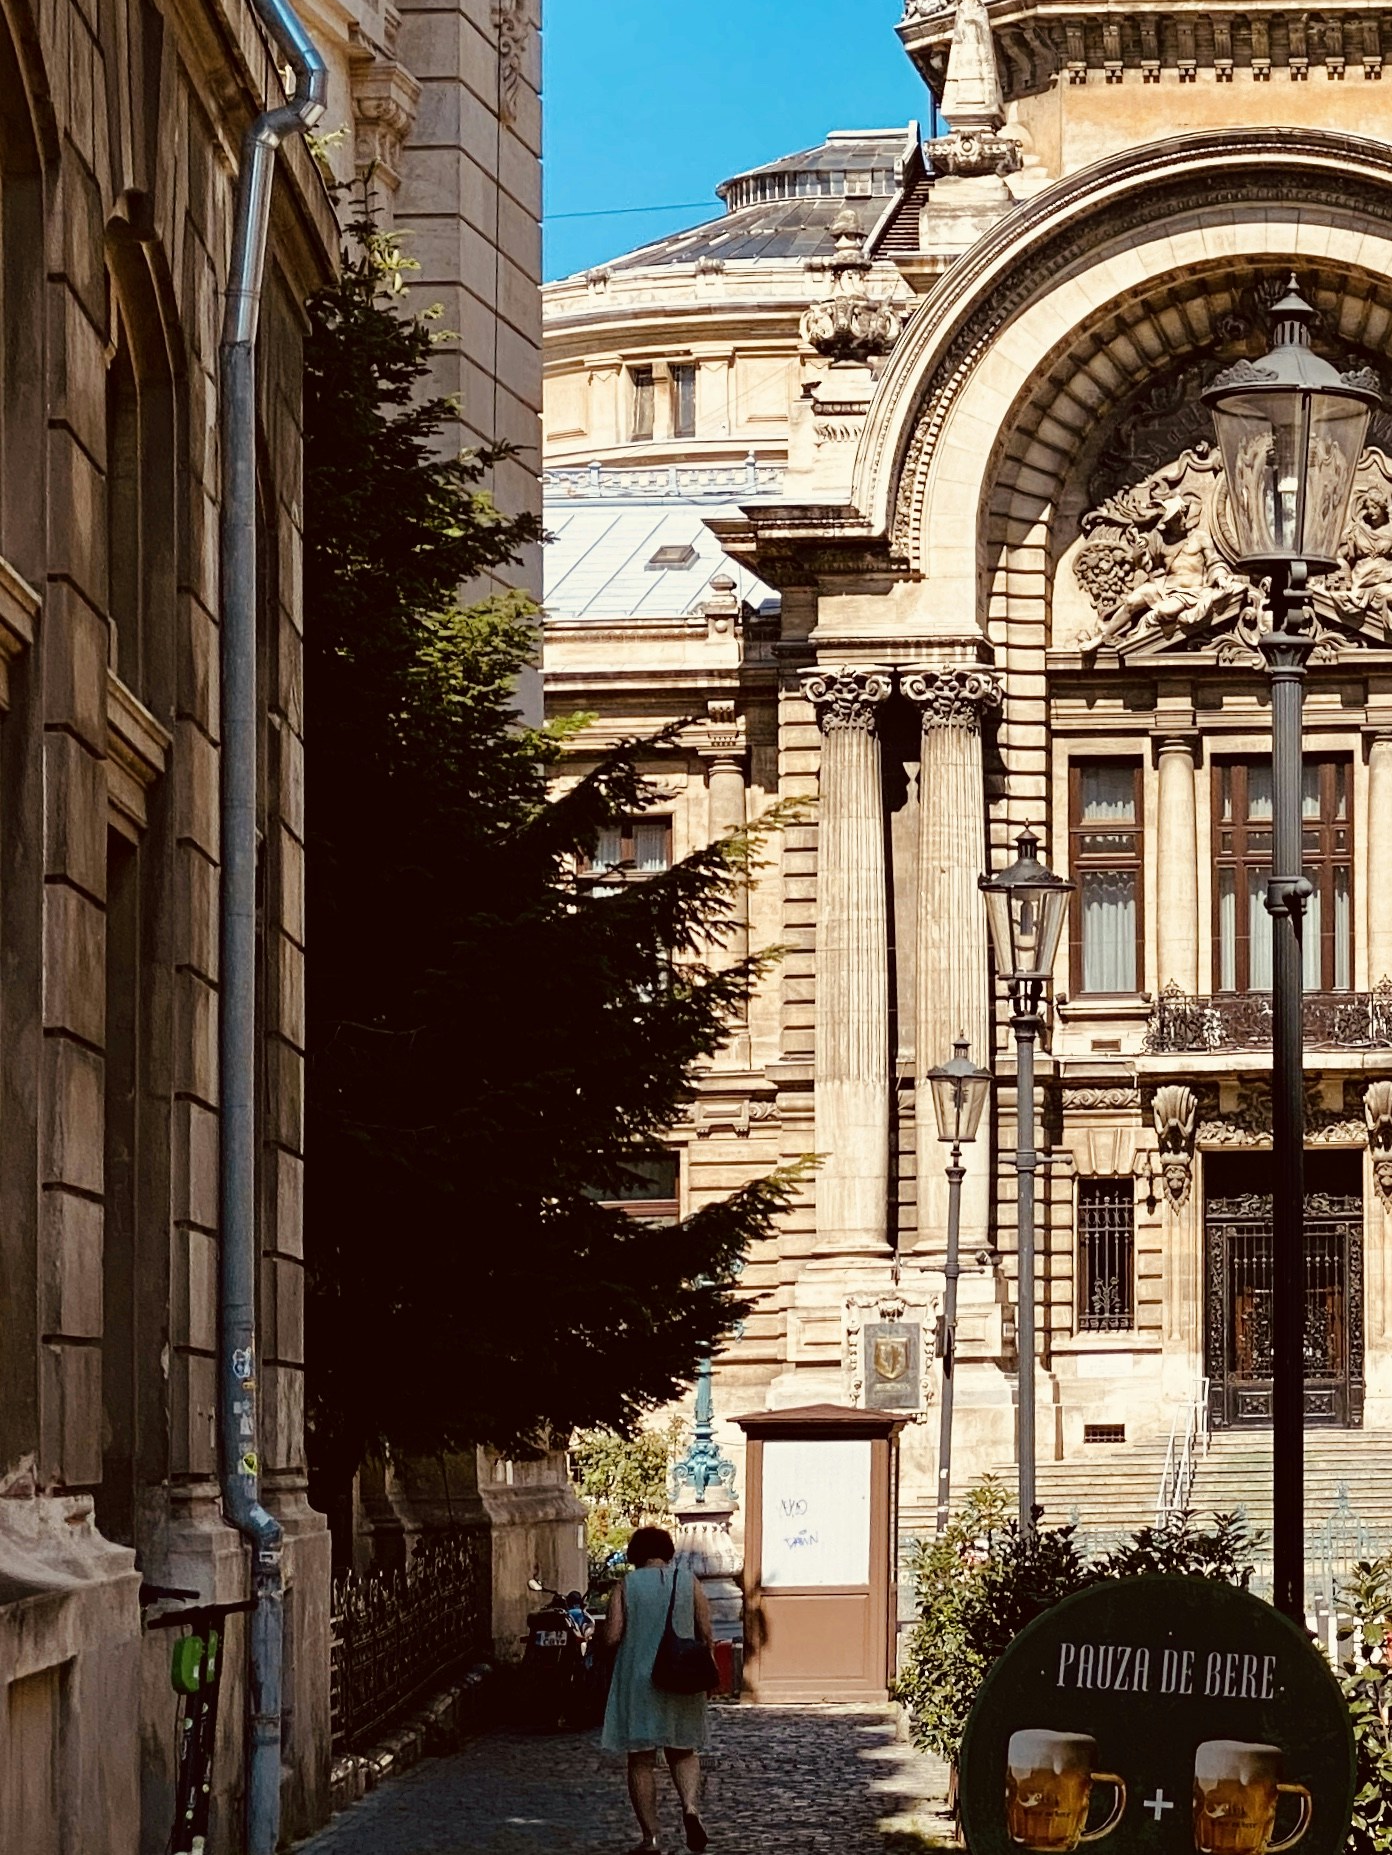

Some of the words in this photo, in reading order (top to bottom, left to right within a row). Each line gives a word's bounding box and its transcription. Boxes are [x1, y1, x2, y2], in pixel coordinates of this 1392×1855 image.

[1056, 1643, 1150, 1692] PAUZA
[1160, 1649, 1195, 1695] DE
[1203, 1651, 1277, 1699] BERE
